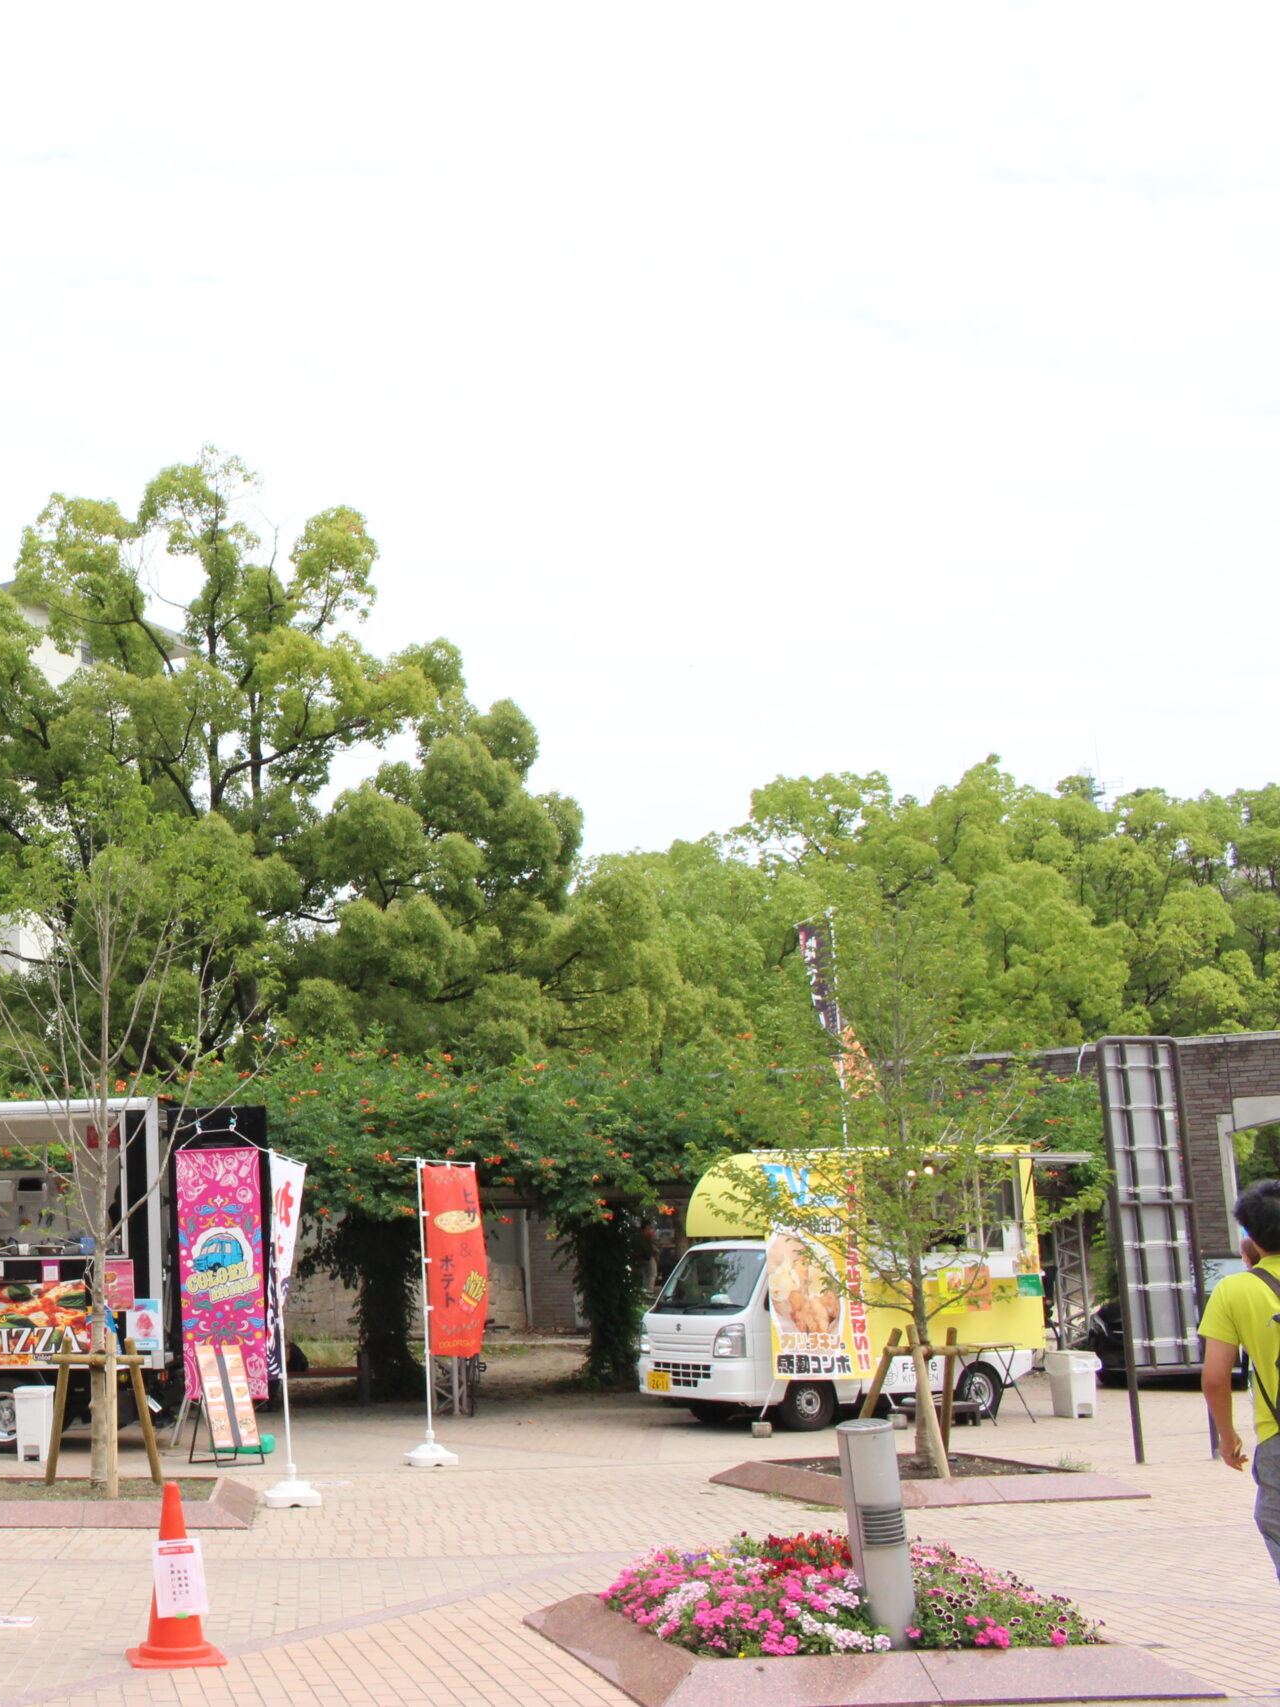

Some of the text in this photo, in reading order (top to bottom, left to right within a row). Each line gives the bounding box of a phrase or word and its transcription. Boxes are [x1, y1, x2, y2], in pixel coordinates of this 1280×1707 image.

[460, 1242, 472, 1258] &
[902, 1361, 938, 1373] Fae
[902, 1373, 939, 1383] KITEN
